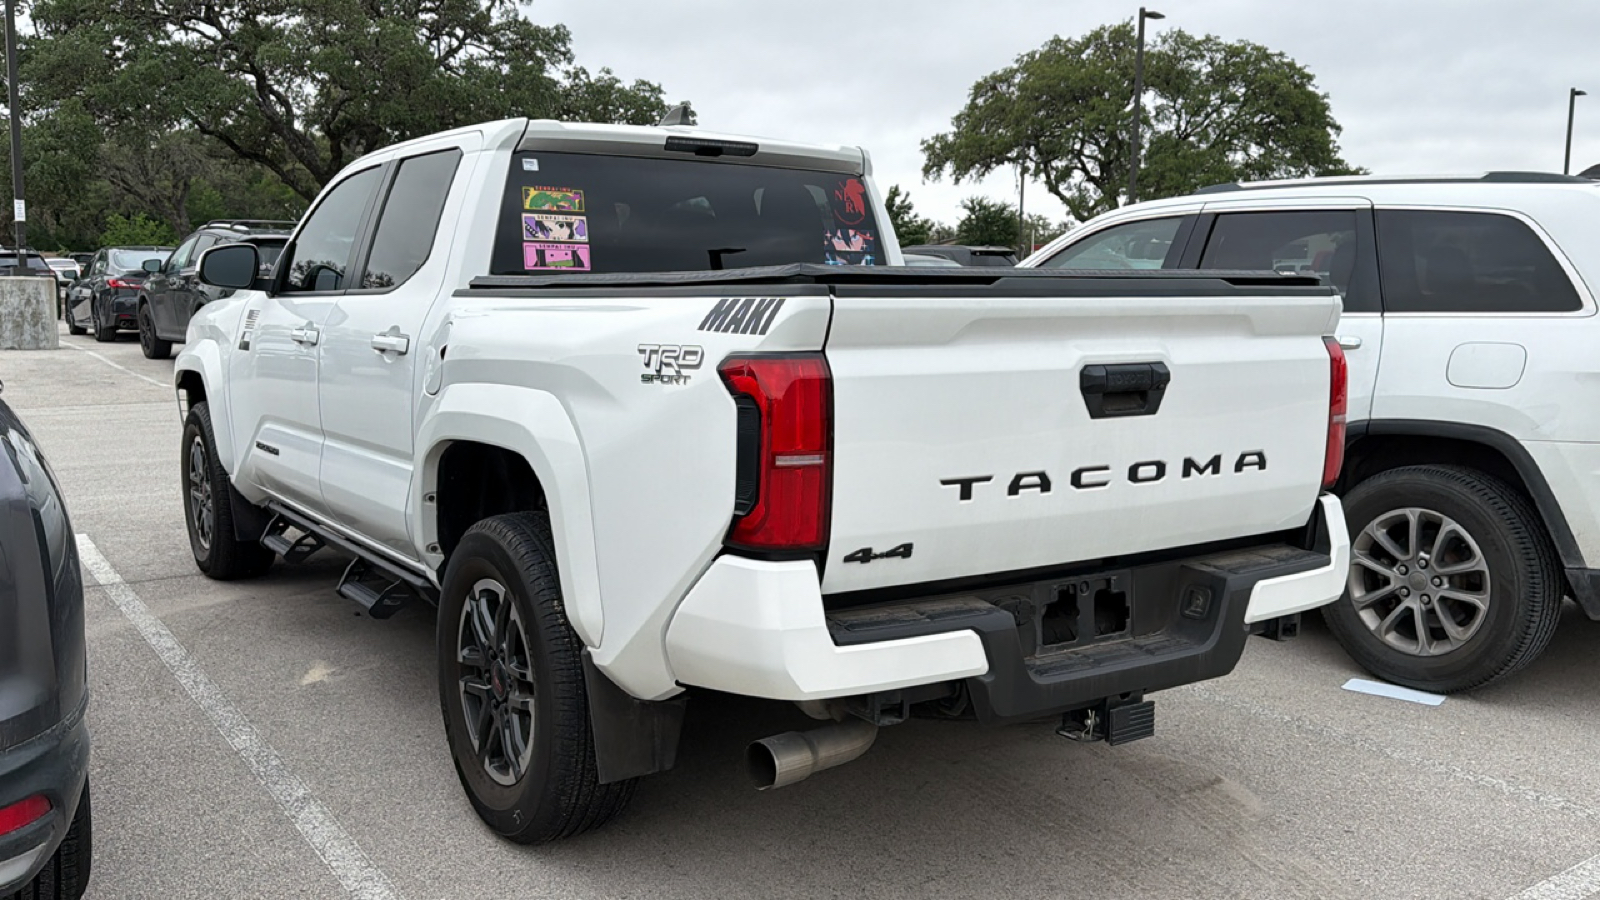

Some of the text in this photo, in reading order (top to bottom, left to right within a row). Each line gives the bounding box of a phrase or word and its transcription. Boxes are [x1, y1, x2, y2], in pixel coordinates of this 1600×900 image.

[697, 298, 786, 335] MAKI
[637, 343, 704, 376] TRD
[640, 373, 691, 385] SPORT
[939, 449, 1267, 501] TACOMA
